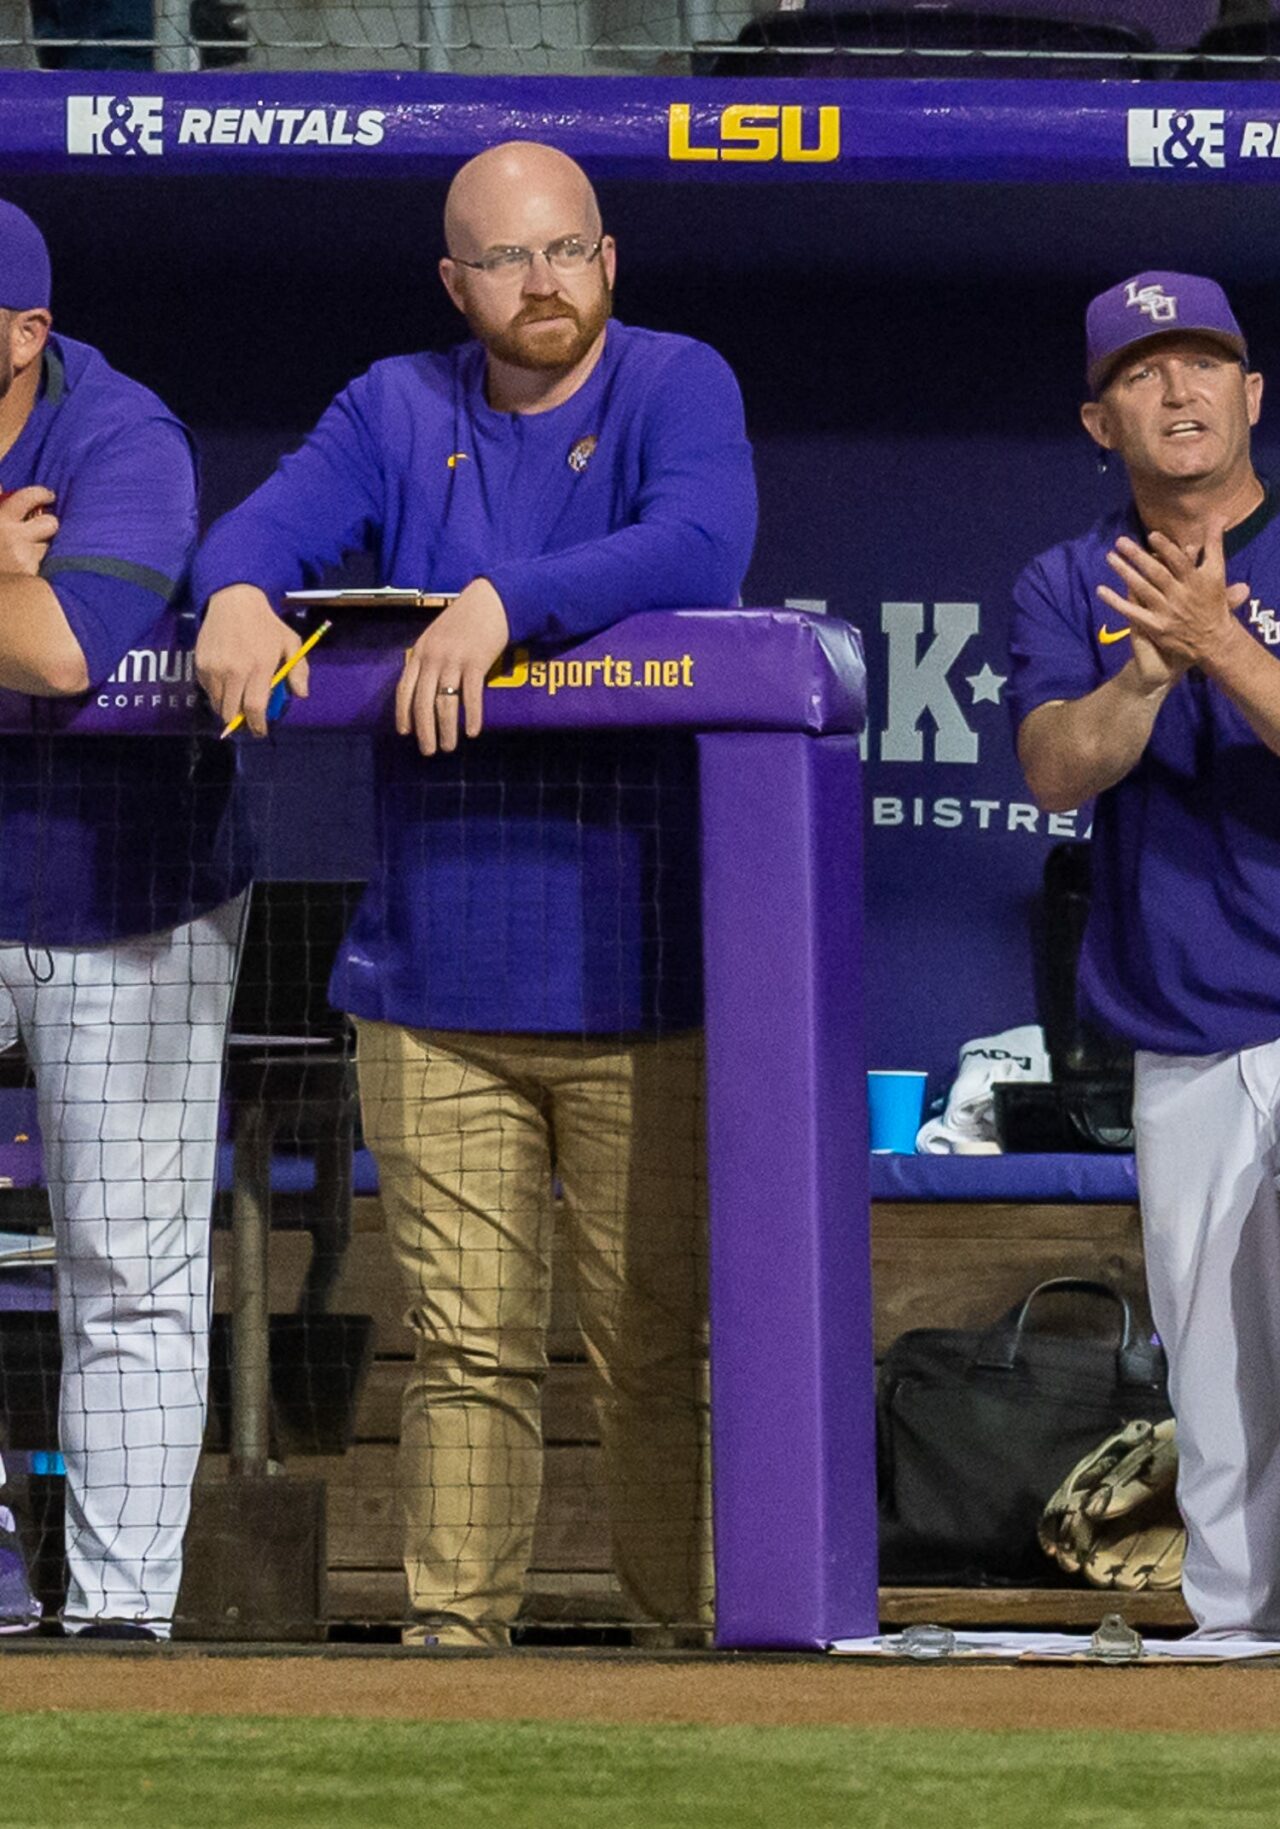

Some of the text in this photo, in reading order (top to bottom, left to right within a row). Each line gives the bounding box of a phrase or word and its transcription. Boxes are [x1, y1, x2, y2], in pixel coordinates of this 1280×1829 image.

[66, 95, 386, 155] H&E RENTALS
[668, 103, 842, 162] LSU
[1127, 108, 1226, 168] H&E
[1123, 279, 1177, 321] LSU
[97, 693, 197, 708] COFFEE
[872, 796, 1093, 840] BISTRE
